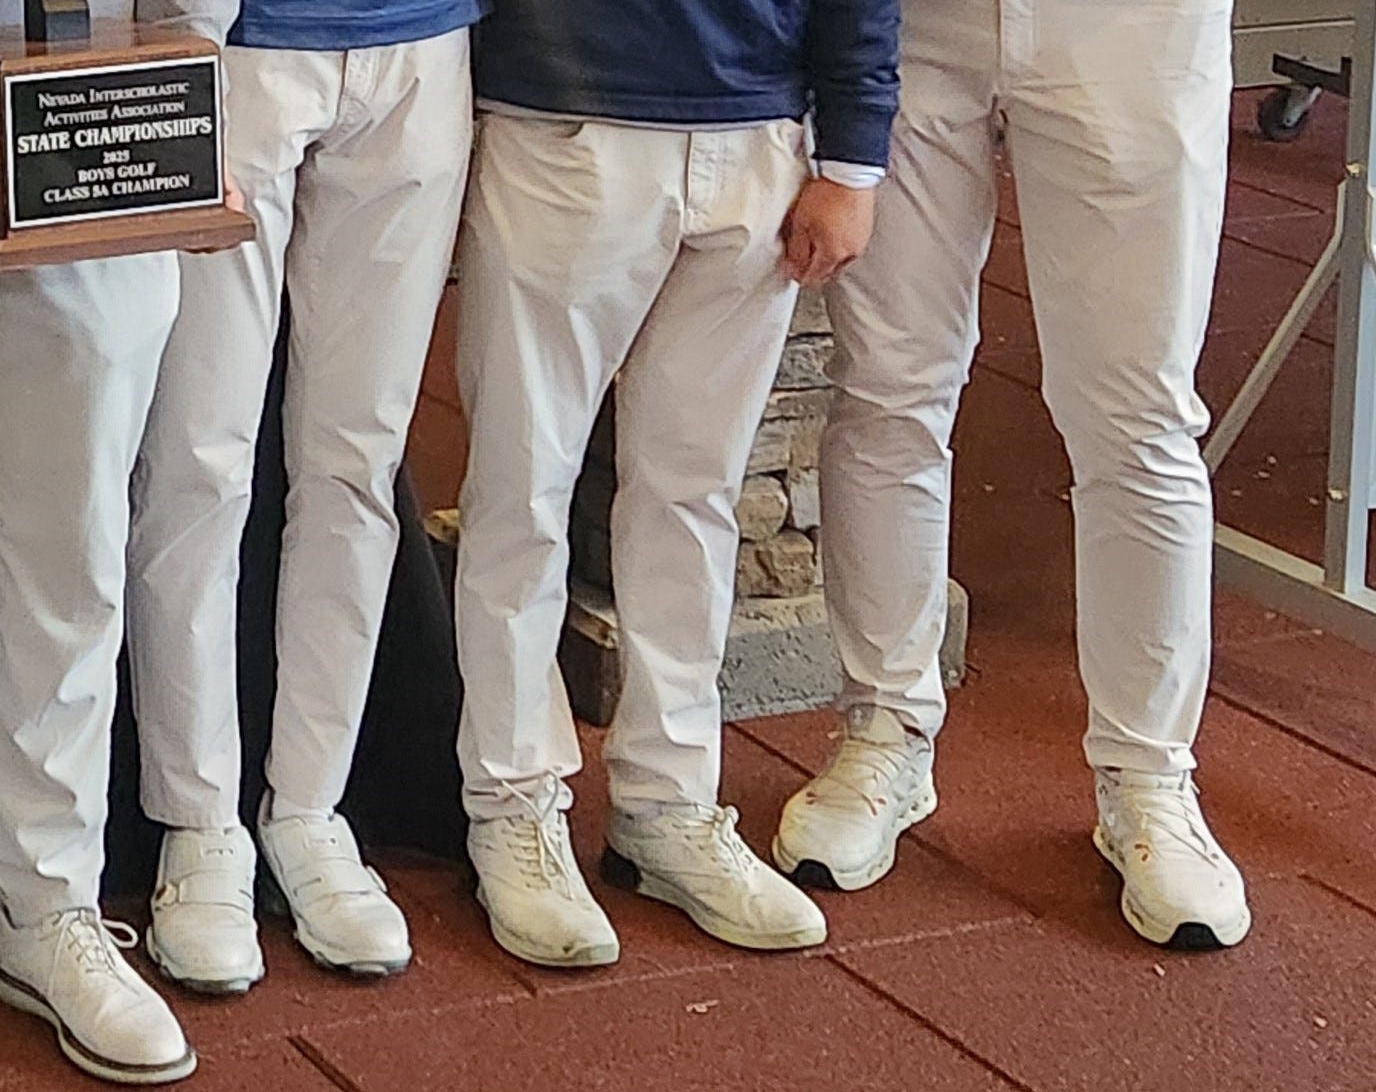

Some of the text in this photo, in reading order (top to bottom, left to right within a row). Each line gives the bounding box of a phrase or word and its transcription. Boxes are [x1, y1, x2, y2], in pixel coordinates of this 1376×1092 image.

[17, 116, 213, 154] STATE CHAMPIONSHIPS
[77, 161, 157, 183] BOYS GOLF
[44, 186, 90, 202] CLASS
[112, 173, 190, 196] CHAMPION
